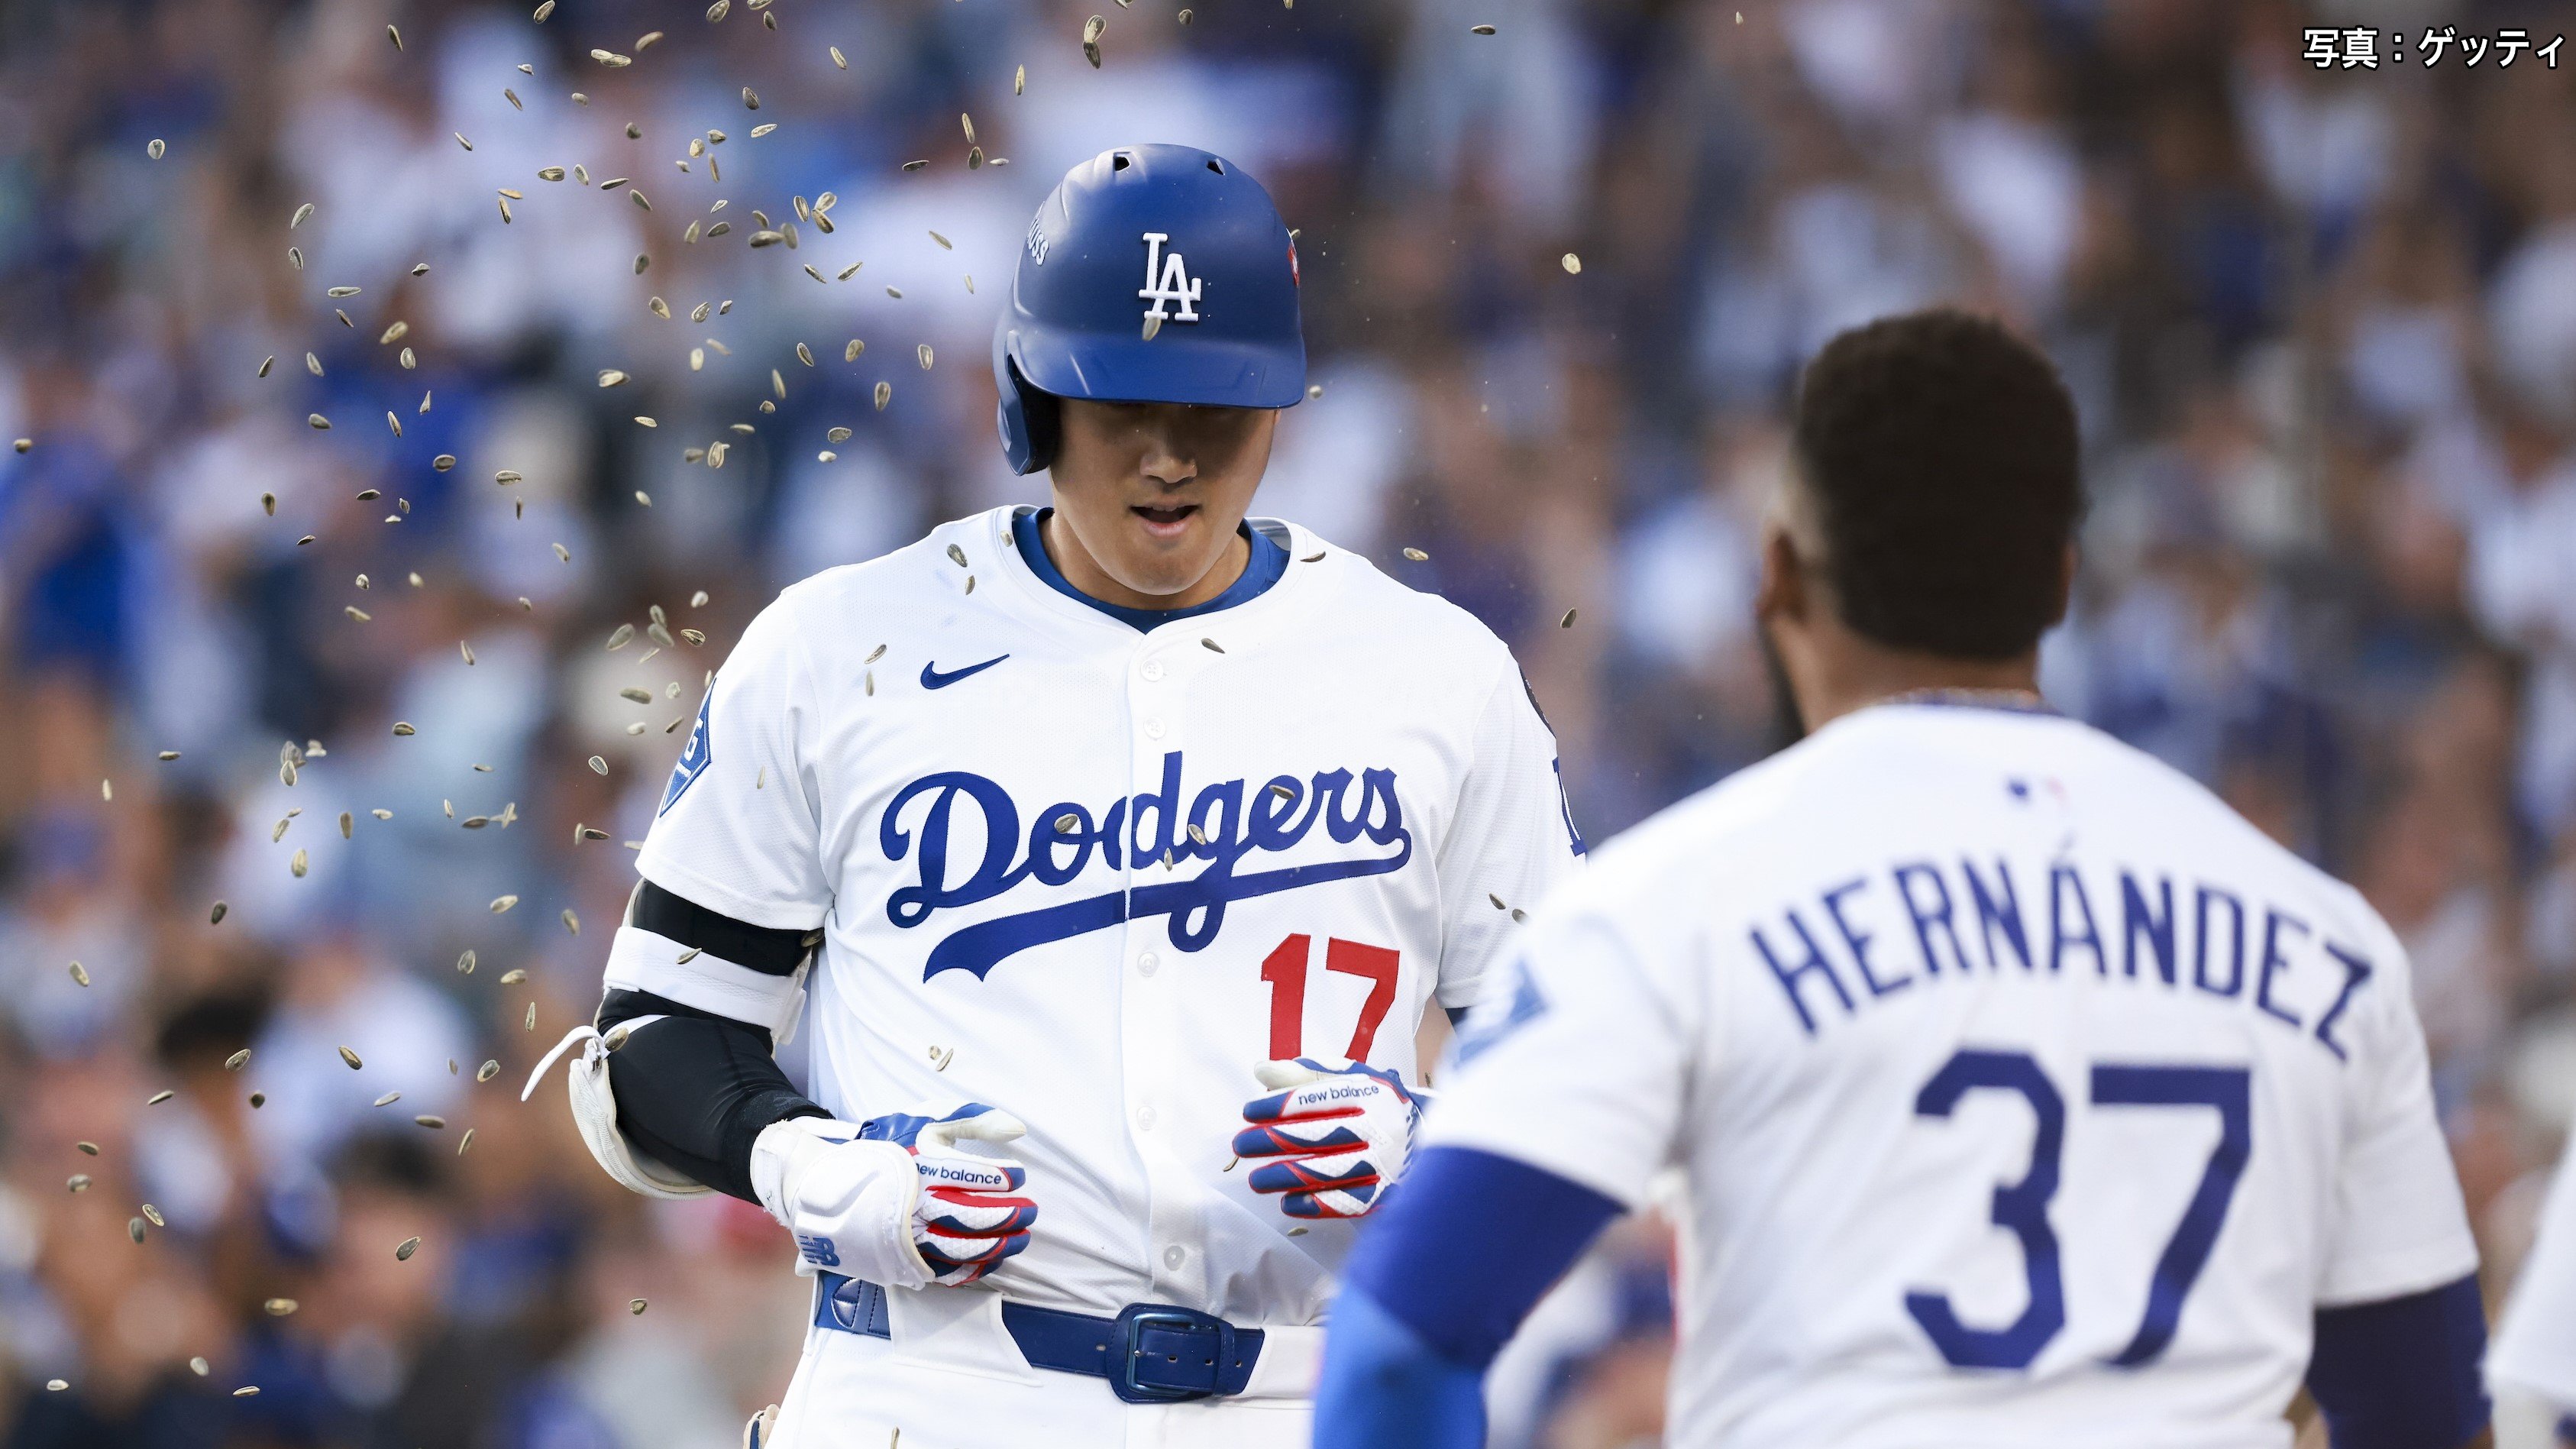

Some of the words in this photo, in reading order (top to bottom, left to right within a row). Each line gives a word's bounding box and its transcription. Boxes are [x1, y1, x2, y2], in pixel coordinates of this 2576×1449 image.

[1138, 232, 1202, 322] LA
[879, 750, 1412, 953] Dodgers
[1260, 933, 1401, 1062] 17
[1298, 1091, 1327, 1105] new
[1330, 1085, 1379, 1100] balance
[940, 1166, 1002, 1185] balance
[1902, 1046, 2254, 1372] 37
